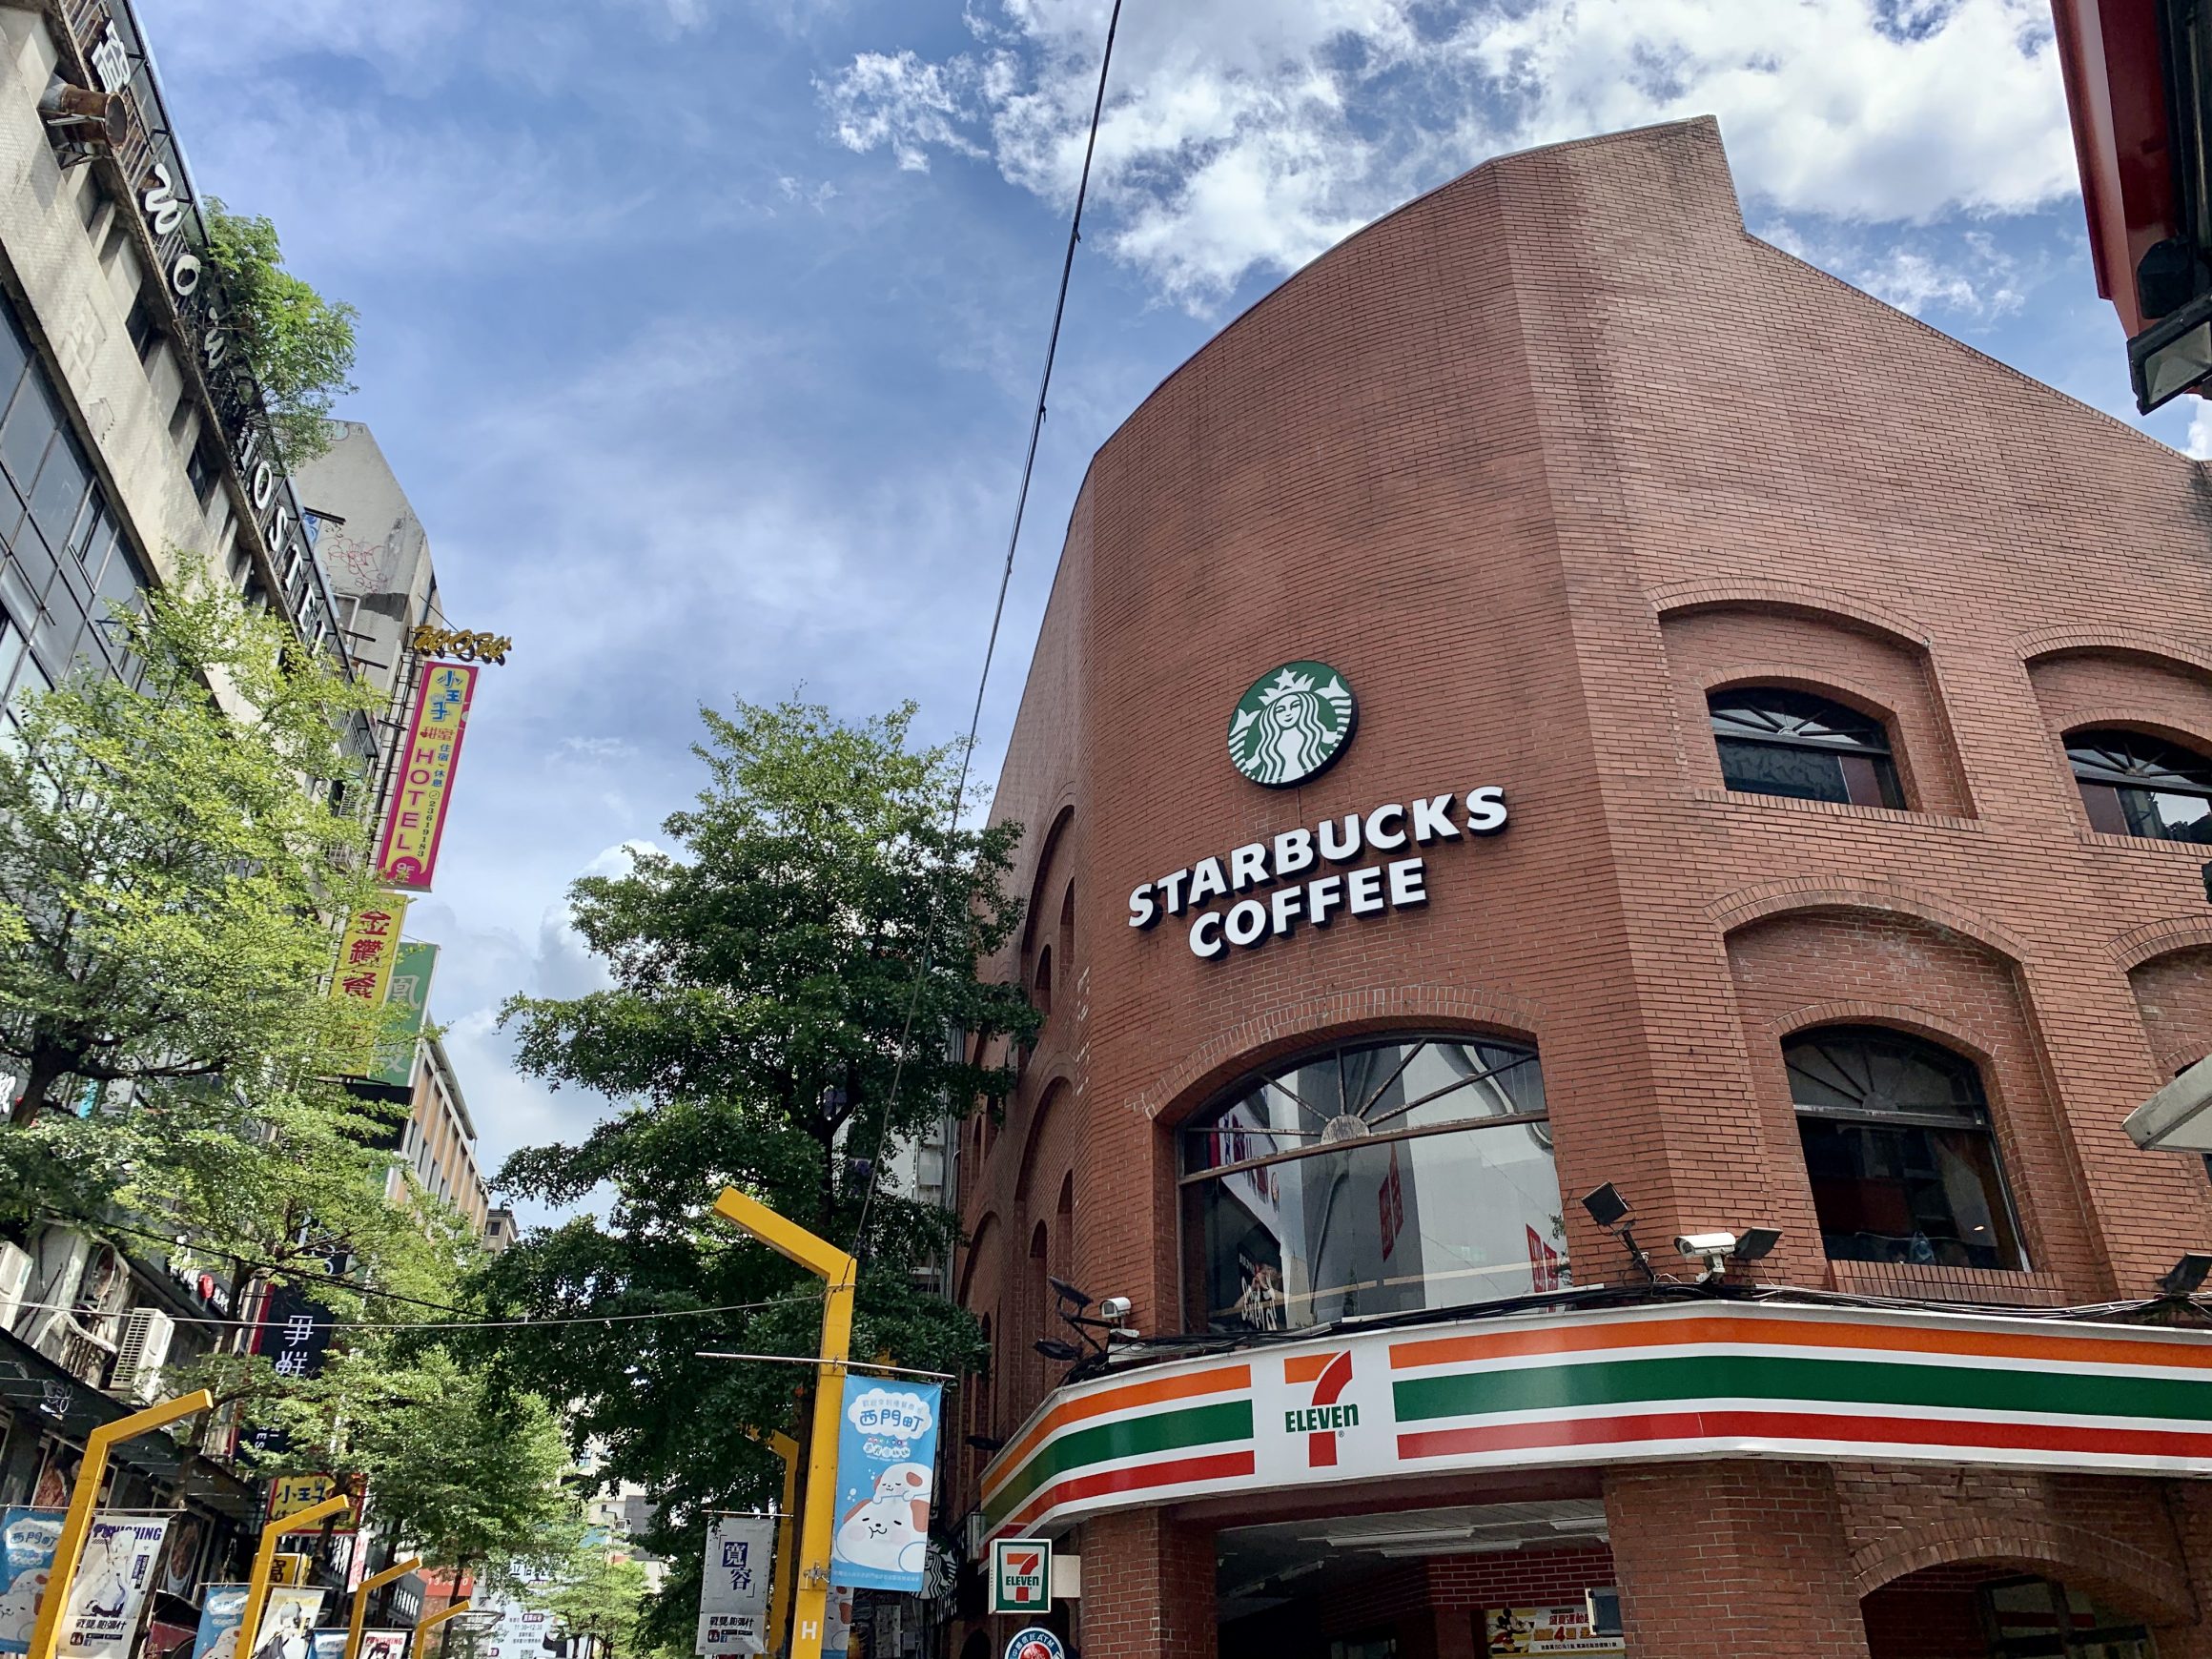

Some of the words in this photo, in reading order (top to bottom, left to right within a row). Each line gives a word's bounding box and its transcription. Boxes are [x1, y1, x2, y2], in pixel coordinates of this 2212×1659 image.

[430, 670, 463, 721] 小王子
[396, 748, 435, 850] HOTEL
[1128, 786, 1508, 928] STARBUCKS
[1188, 856, 1426, 958] COFFEE
[859, 1408, 924, 1432] 西門町
[801, 1622, 817, 1640] H
[1036, 1633, 1055, 1649] ATM
